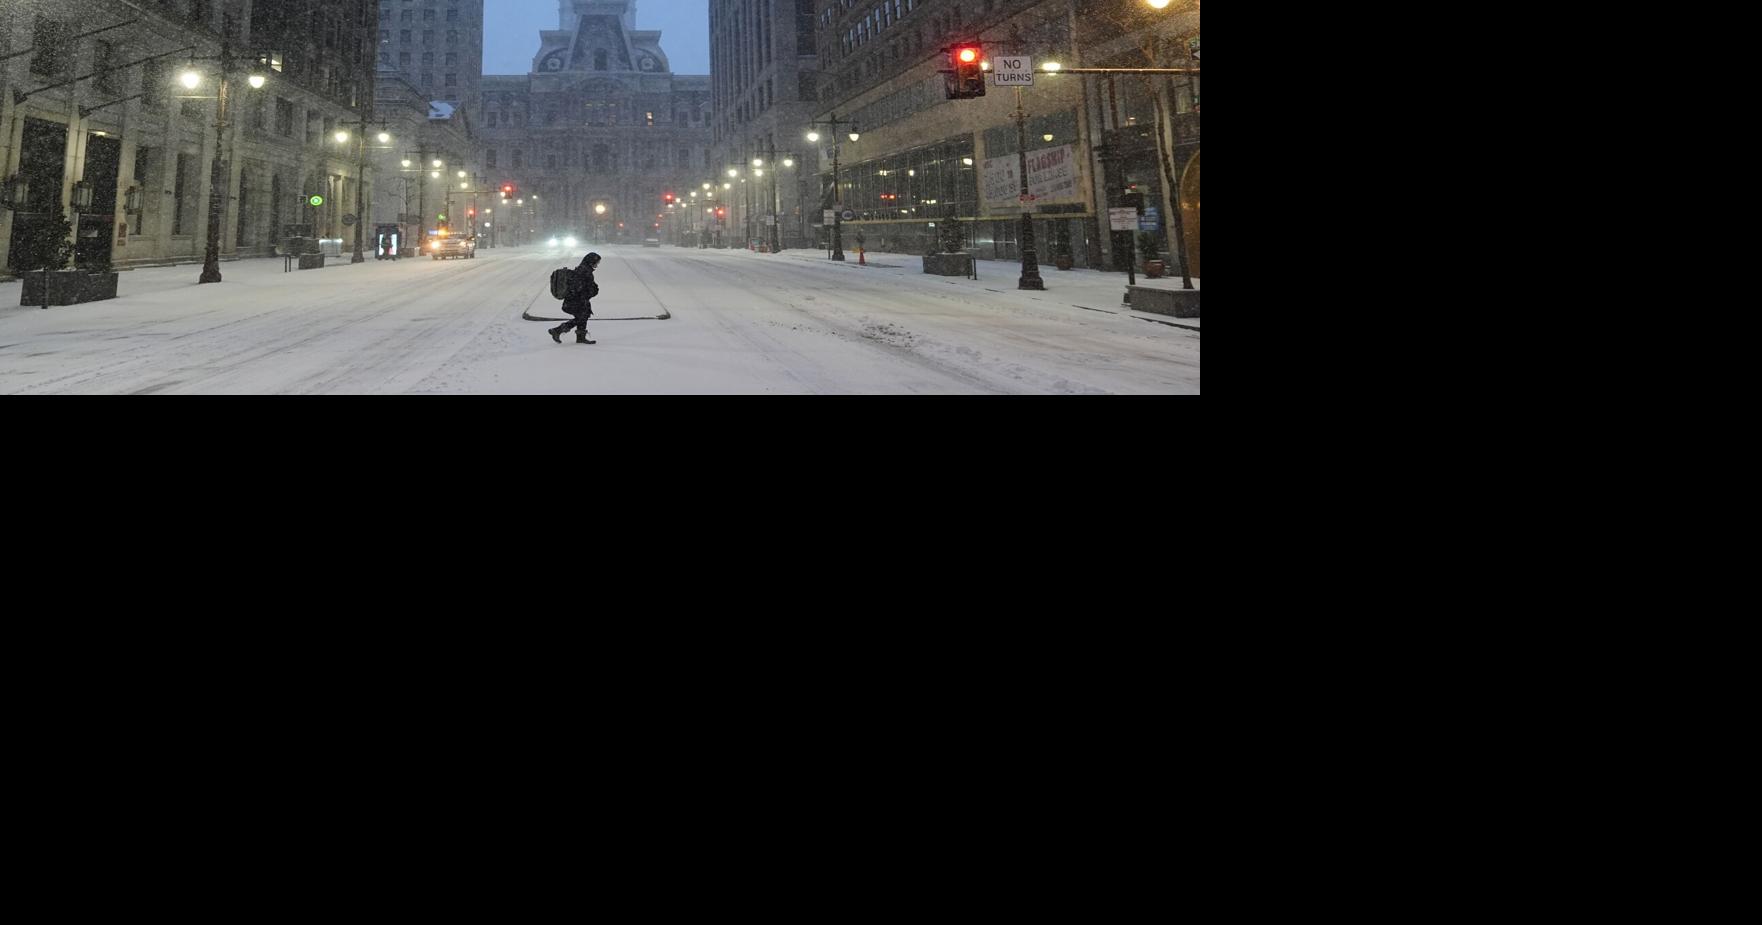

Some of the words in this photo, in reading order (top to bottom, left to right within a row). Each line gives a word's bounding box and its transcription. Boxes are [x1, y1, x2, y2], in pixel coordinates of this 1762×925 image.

[1003, 59, 1022, 70] NO
[995, 72, 1032, 82] TURNS
[1027, 148, 1065, 175] FLAGSHIP
